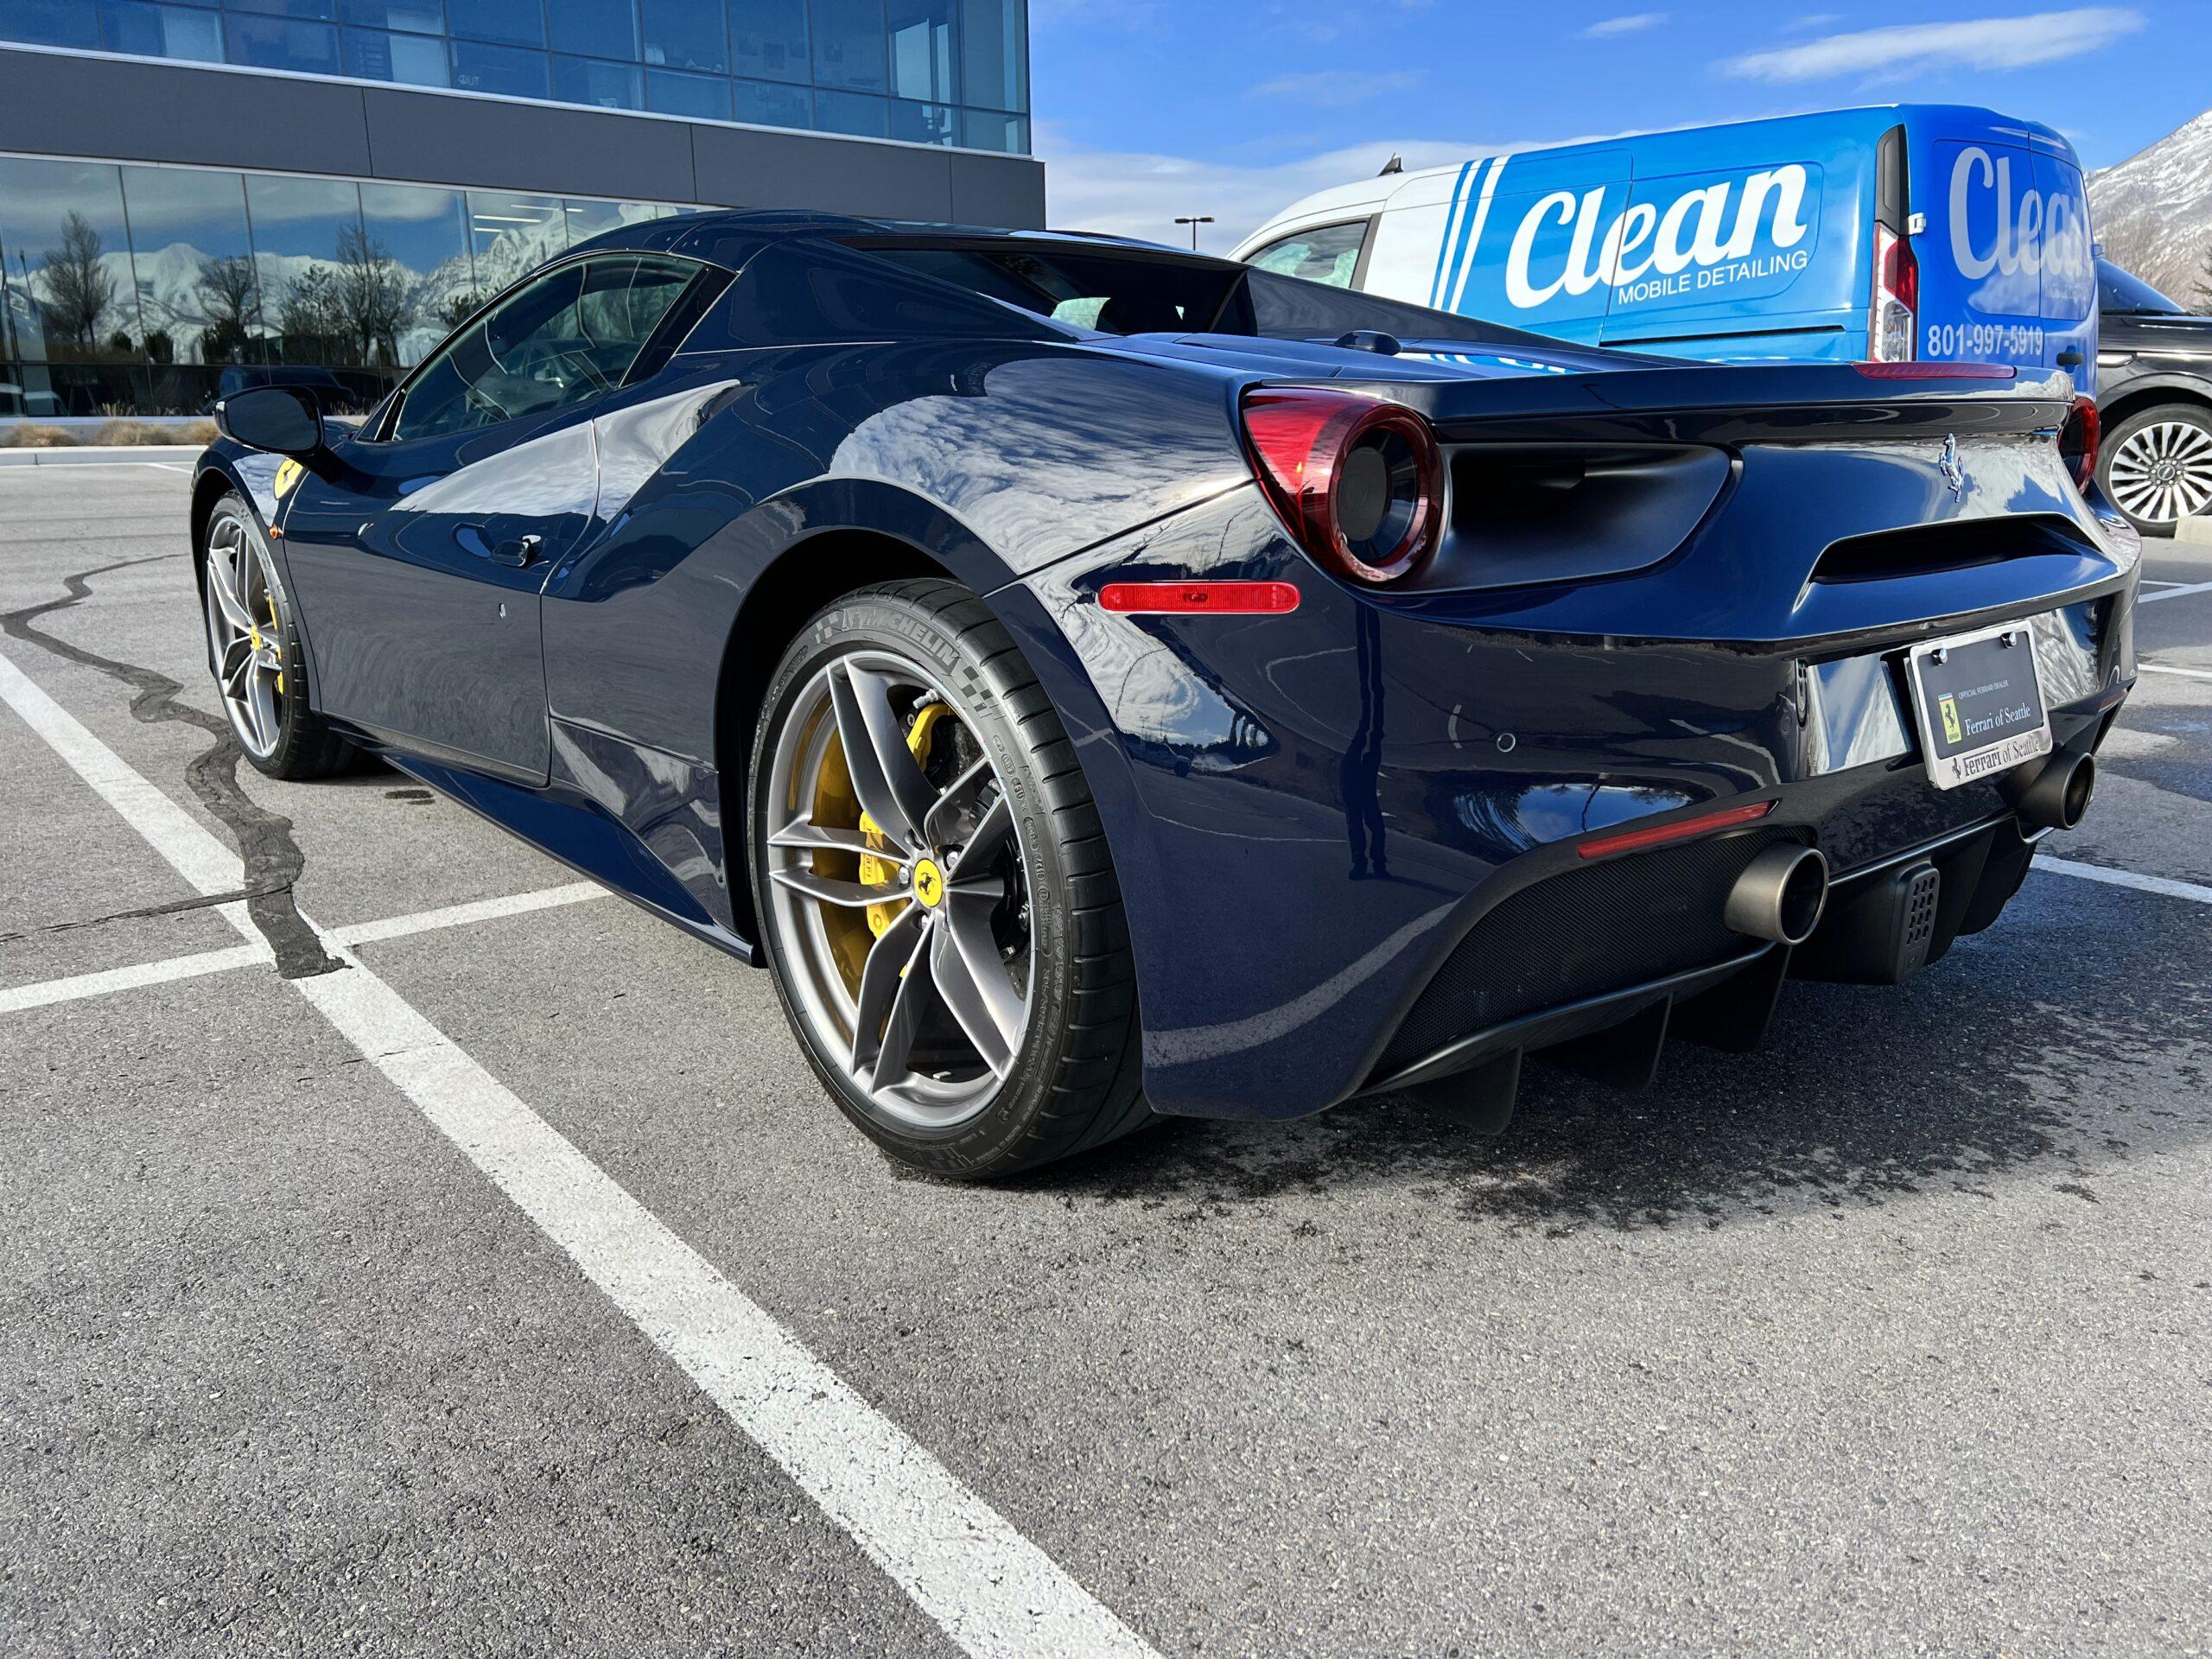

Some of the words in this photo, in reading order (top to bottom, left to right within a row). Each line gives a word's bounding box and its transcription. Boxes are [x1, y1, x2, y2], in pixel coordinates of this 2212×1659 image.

[1505, 163, 1808, 309] Clean
[1618, 272, 1692, 304] MOBILE
[1696, 250, 1808, 289] DETAILING
[1928, 323, 2044, 357] 801-997-5919
[1993, 679, 2010, 690] DEALER
[1964, 712, 1994, 736] Ferrari
[1994, 709, 2004, 727] of
[2005, 702, 2031, 722] Seattle
[1963, 747, 2002, 777] Ferrari
[2002, 742, 2014, 764] of
[2014, 734, 2039, 760] Seattle
